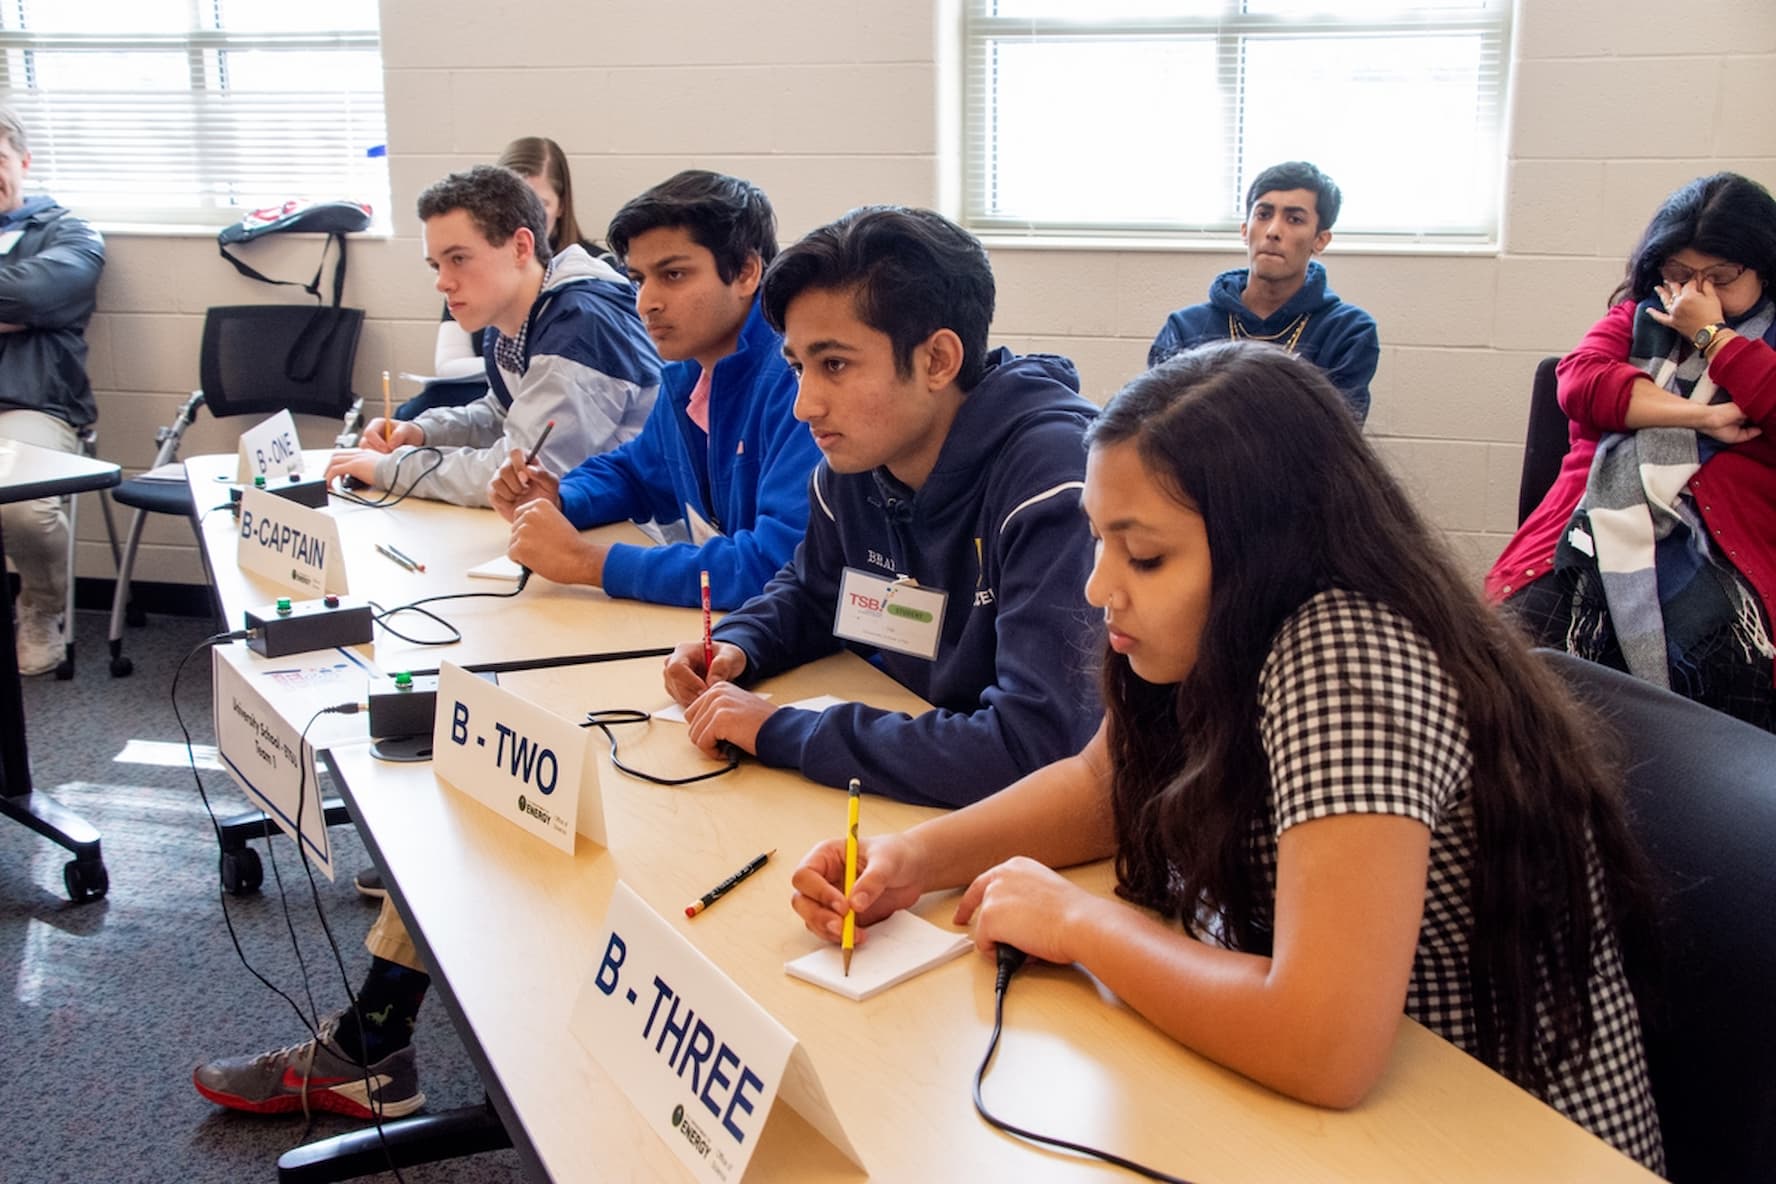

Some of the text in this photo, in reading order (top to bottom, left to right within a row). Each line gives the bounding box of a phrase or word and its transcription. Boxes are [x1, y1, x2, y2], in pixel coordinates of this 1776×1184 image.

[256, 449, 267, 474] B
[272, 432, 294, 464] ONE
[241, 510, 326, 570] B-CAPTAIN
[233, 697, 260, 736] University
[260, 723, 280, 751] School
[451, 701, 469, 746] B
[495, 722, 559, 795] TWO
[255, 739, 272, 765] Team
[526, 803, 551, 825] ENERGY
[594, 931, 627, 996] B
[642, 975, 765, 1145] THREE
[680, 1119, 712, 1159] ENERGY
